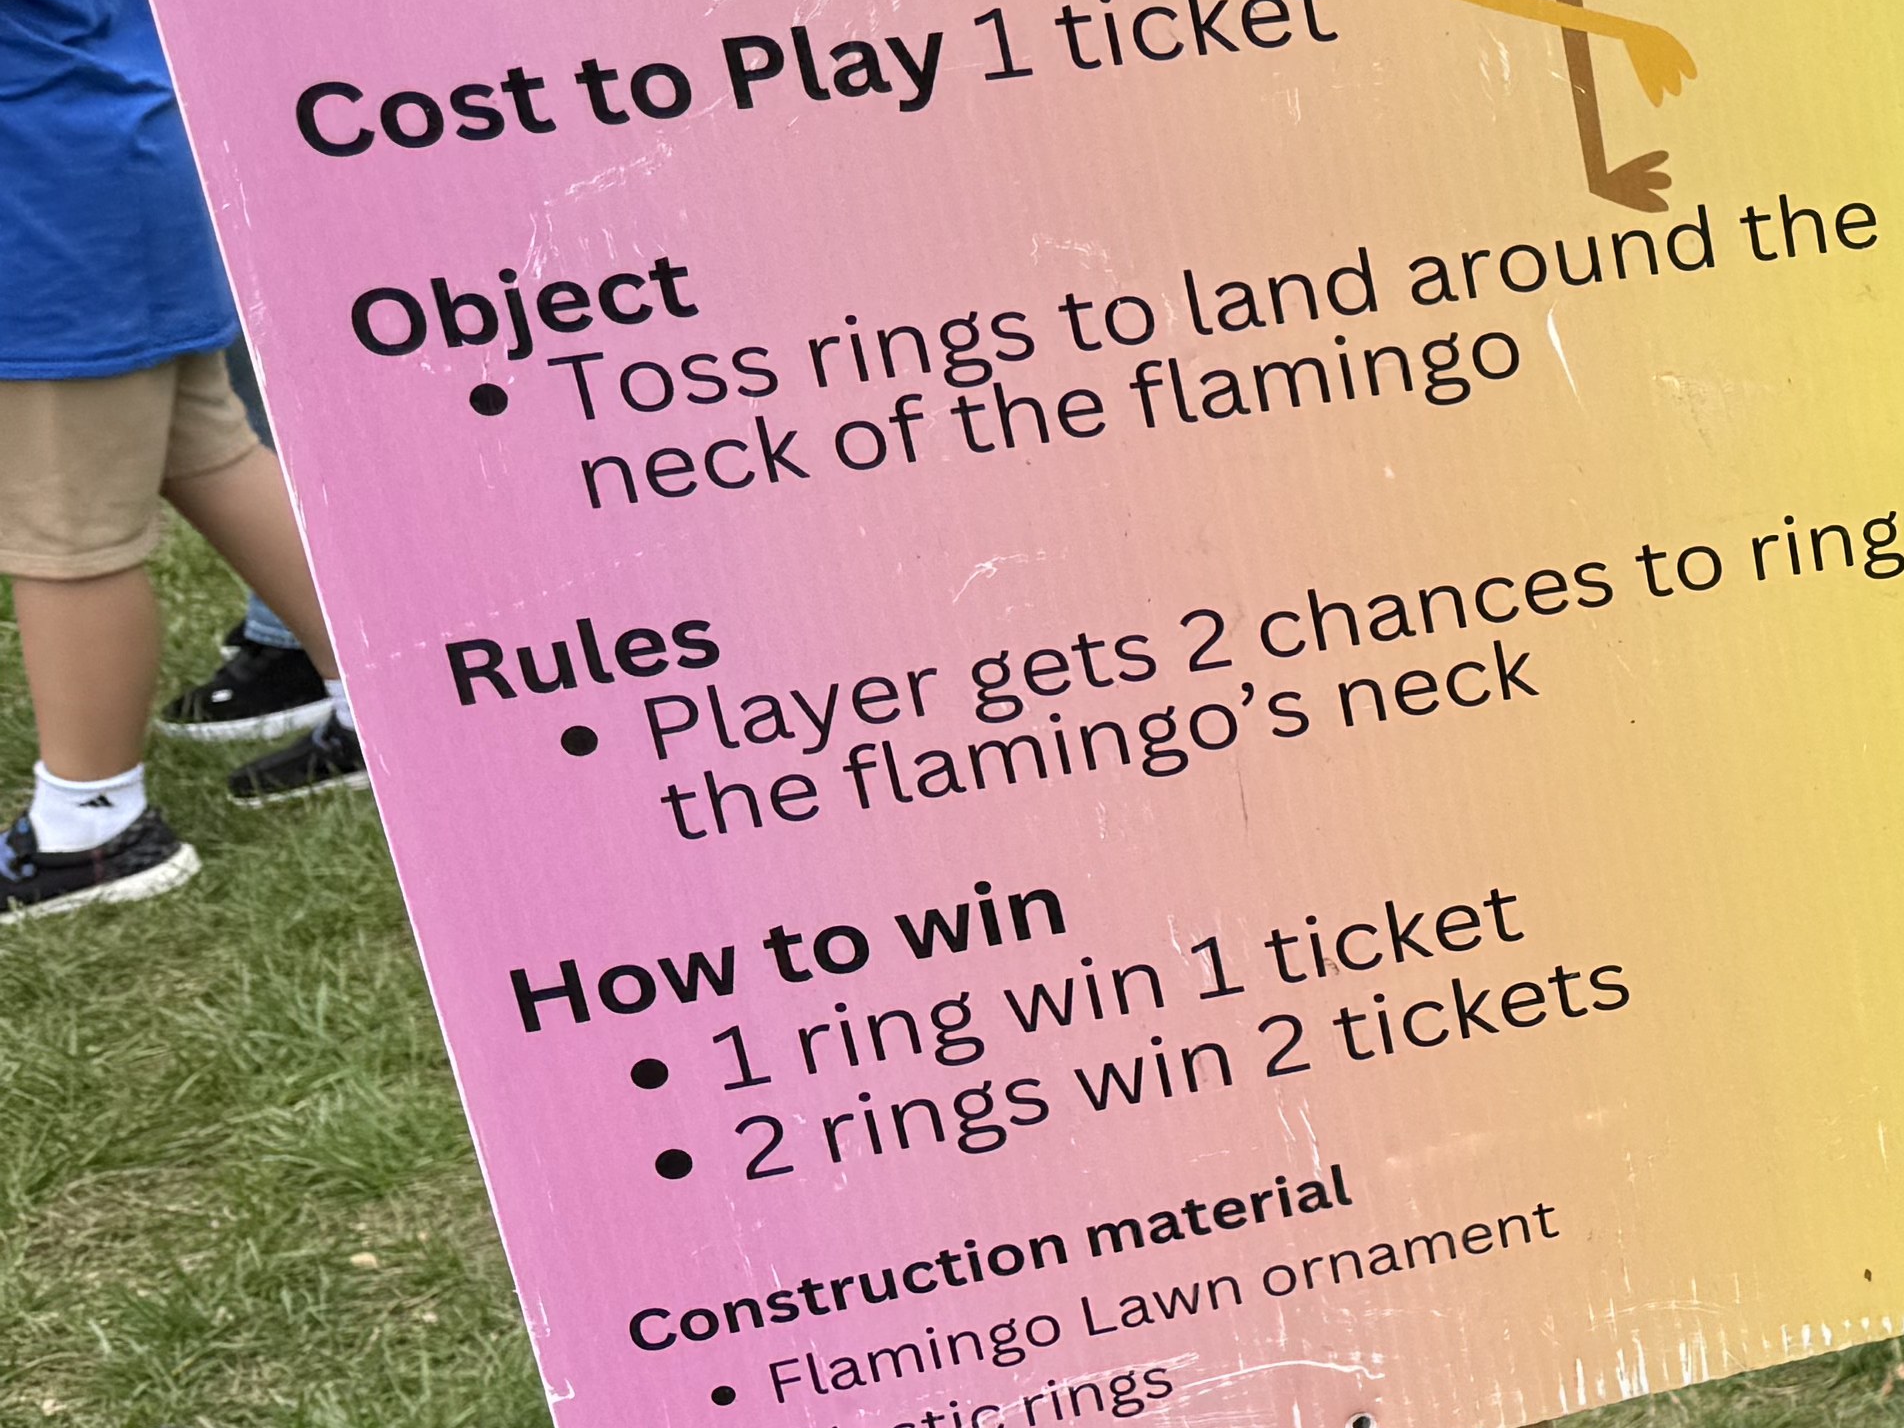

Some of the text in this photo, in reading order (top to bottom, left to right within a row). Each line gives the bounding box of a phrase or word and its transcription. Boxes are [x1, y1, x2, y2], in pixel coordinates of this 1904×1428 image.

[295, 66, 557, 158] Cost
[574, 58, 692, 125] to
[721, 25, 944, 113] Play
[973, 7, 1034, 81] 1
[350, 256, 700, 361] Object
[546, 193, 1878, 421] Toss rings to land around the
[580, 331, 1520, 509] neck of the flamingo
[444, 617, 720, 706] Rules
[643, 667, 938, 761] Player
[971, 632, 1157, 724] gets
[1180, 608, 1233, 673] 2
[1260, 562, 1613, 658] chances
[1635, 544, 1722, 597] to
[660, 639, 1540, 840] the flamingo’s neck
[509, 880, 1066, 1033] How to win
[712, 888, 1525, 1091] 1 ring win 1 ticket
[734, 964, 1630, 1181] 2 rings win 2 tickets
[629, 1163, 1353, 1351] Construction material
[768, 1202, 1560, 1404] Flamingo Lawn ornament
[1023, 1367, 1173, 1427] rings
